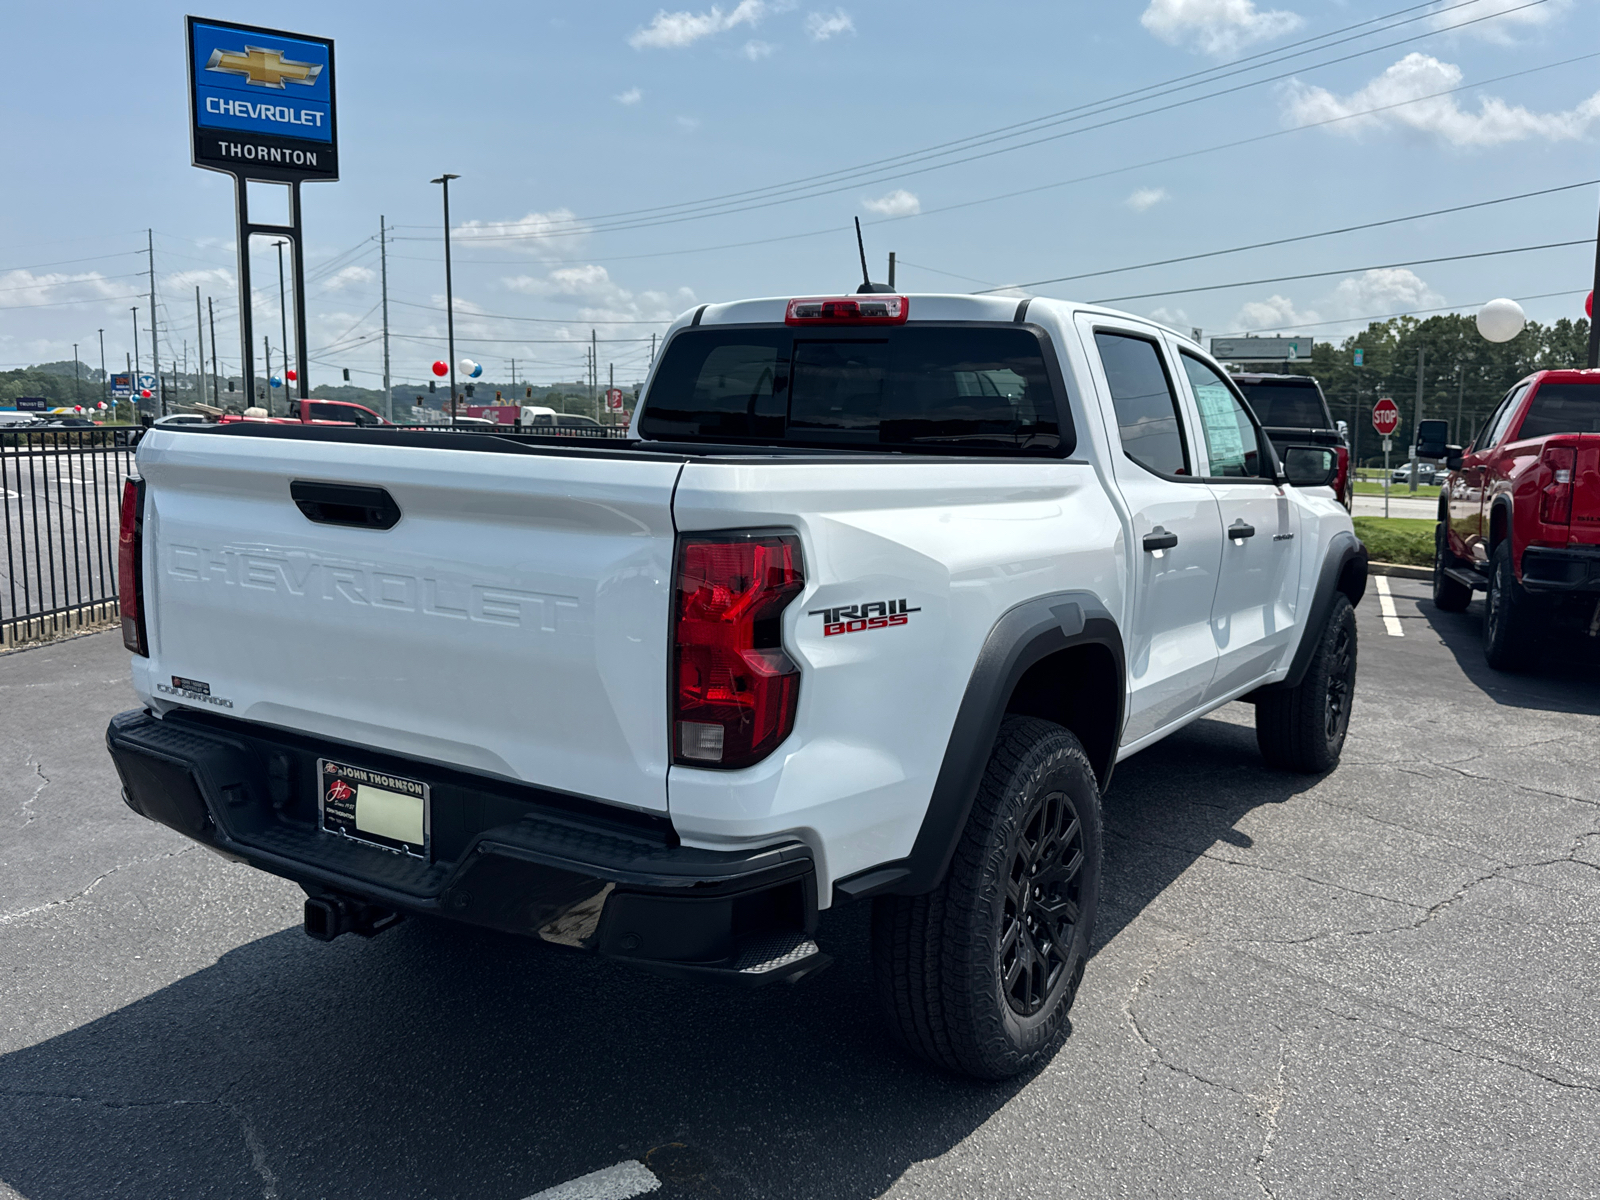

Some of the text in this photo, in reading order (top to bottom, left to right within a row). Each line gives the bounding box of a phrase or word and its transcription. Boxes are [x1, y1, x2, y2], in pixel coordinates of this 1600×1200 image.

[205, 97, 325, 127] CHEVROLET
[218, 141, 318, 166] THORNTON
[1374, 409, 1397, 424] STOP
[167, 543, 579, 632] CHEVROLET
[808, 598, 922, 624] TRAIL
[823, 613, 909, 638] BOSS
[157, 684, 234, 708] COLORADO
[342, 766, 423, 795] JOHN THORNTON
